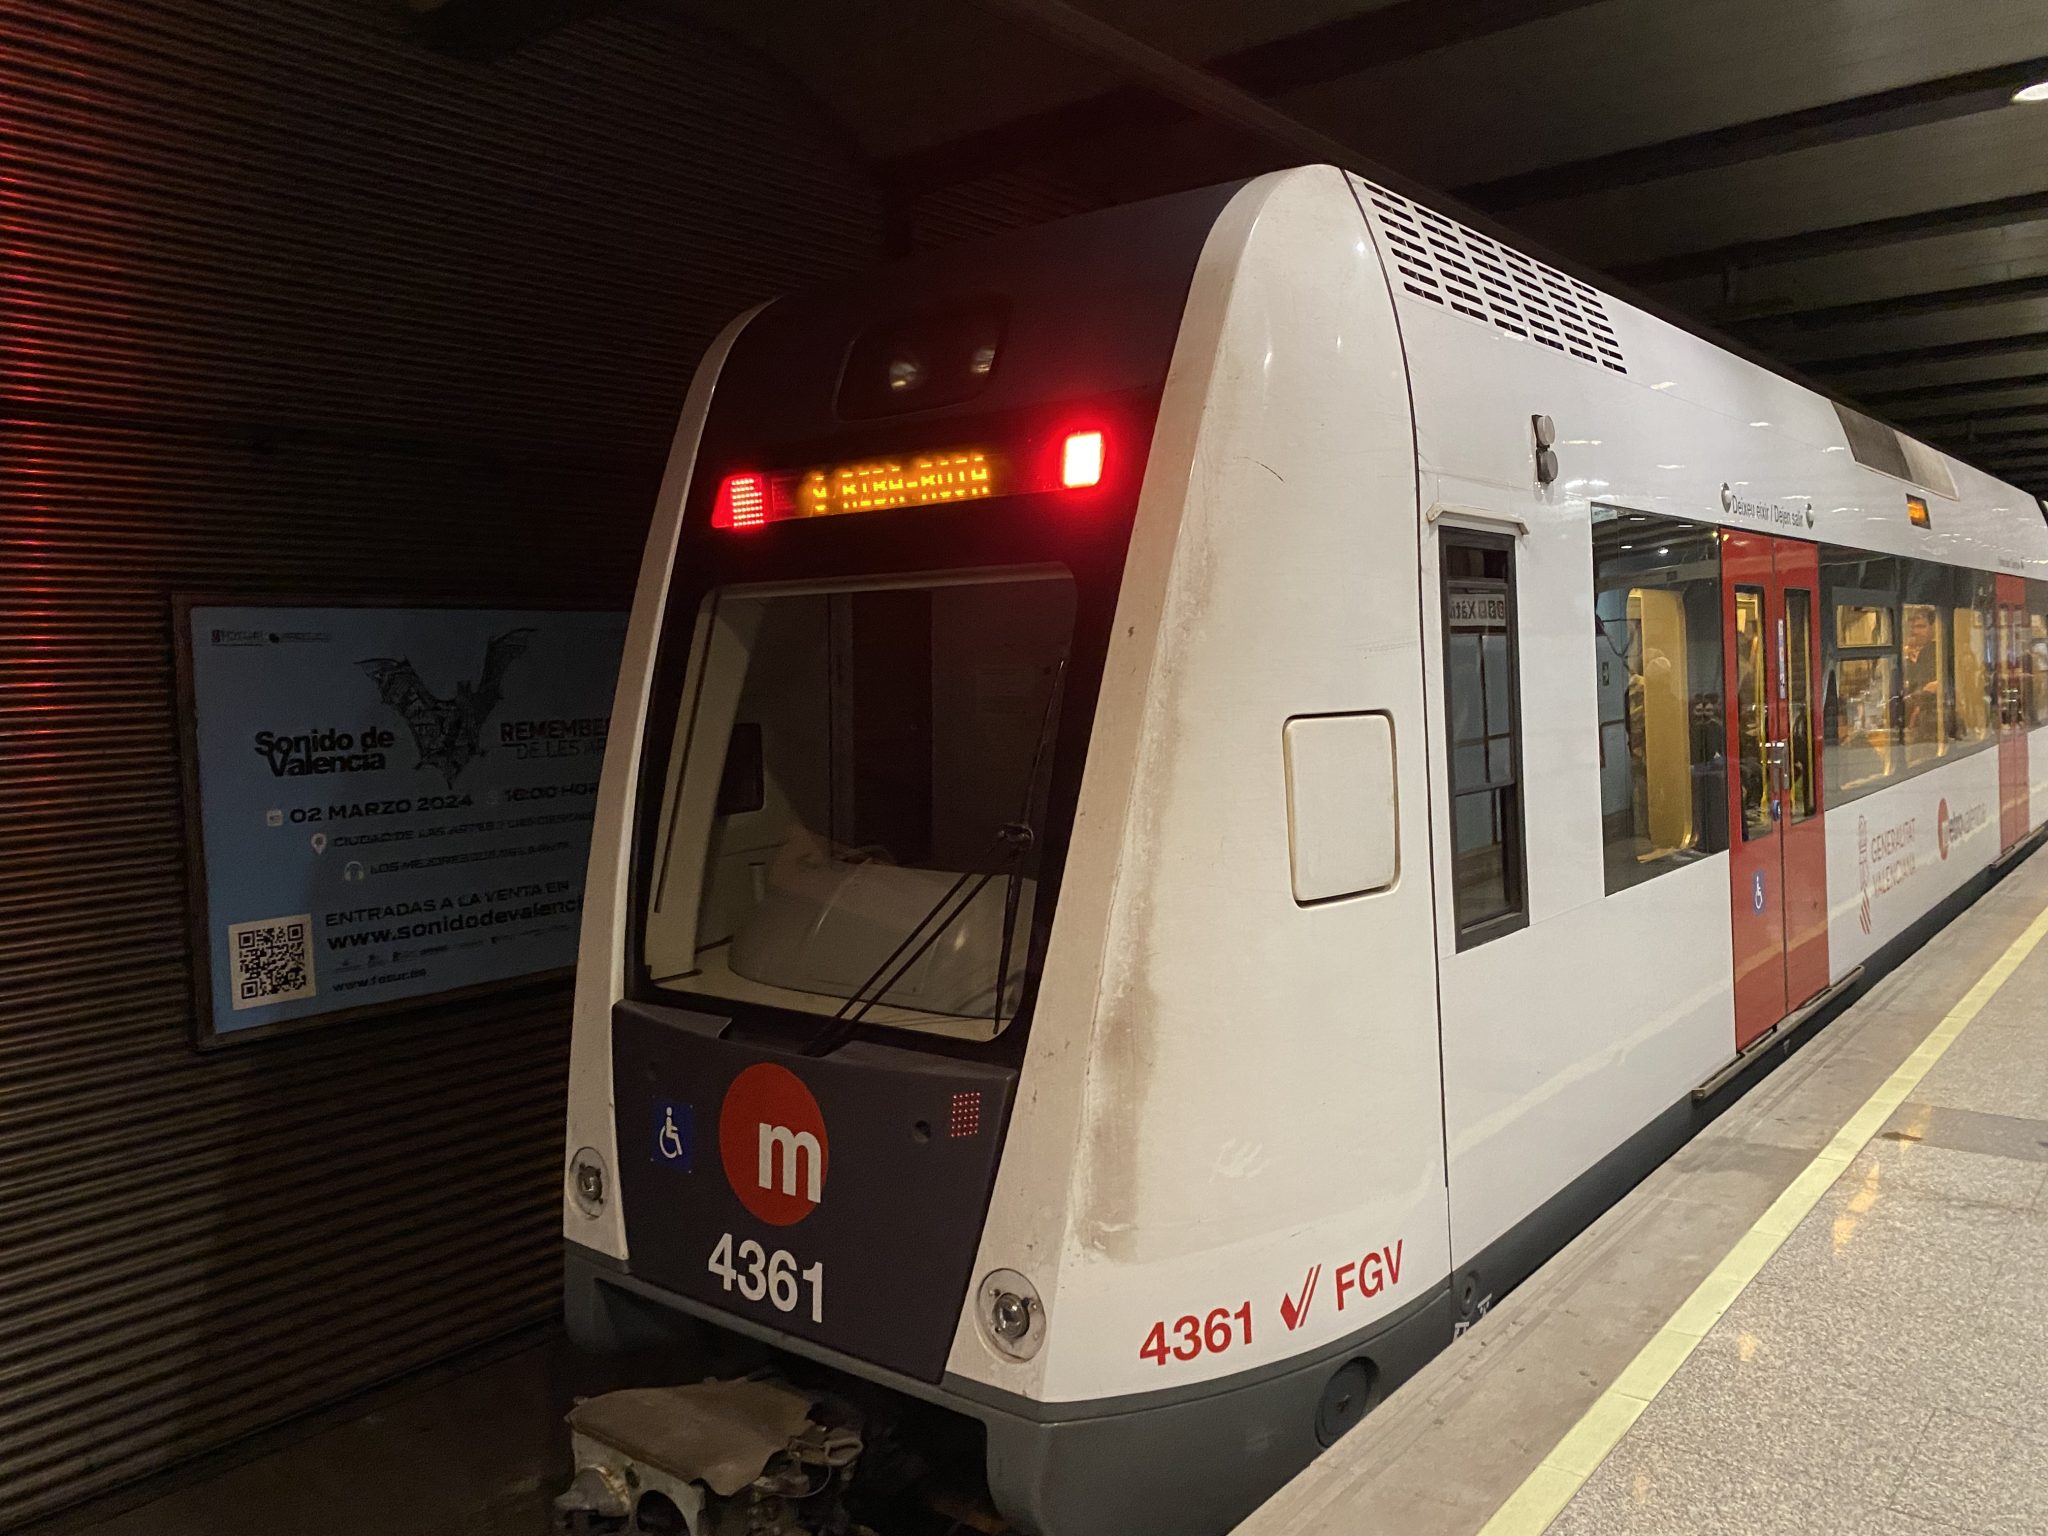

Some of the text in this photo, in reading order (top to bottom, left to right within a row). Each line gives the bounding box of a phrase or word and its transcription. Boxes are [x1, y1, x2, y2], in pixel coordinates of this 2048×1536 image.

[255, 726, 395, 755] Sonido de
[267, 749, 386, 777] Valencia
[290, 808, 322, 823] 02
[329, 799, 411, 820] MARZO
[417, 794, 473, 812] 2024
[326, 880, 569, 927] ENTRADAS A LA VENTA EN
[758, 1122, 822, 1204] m
[708, 1232, 824, 1324] 4361
[1139, 1238, 1404, 1367] 4361 FGV
